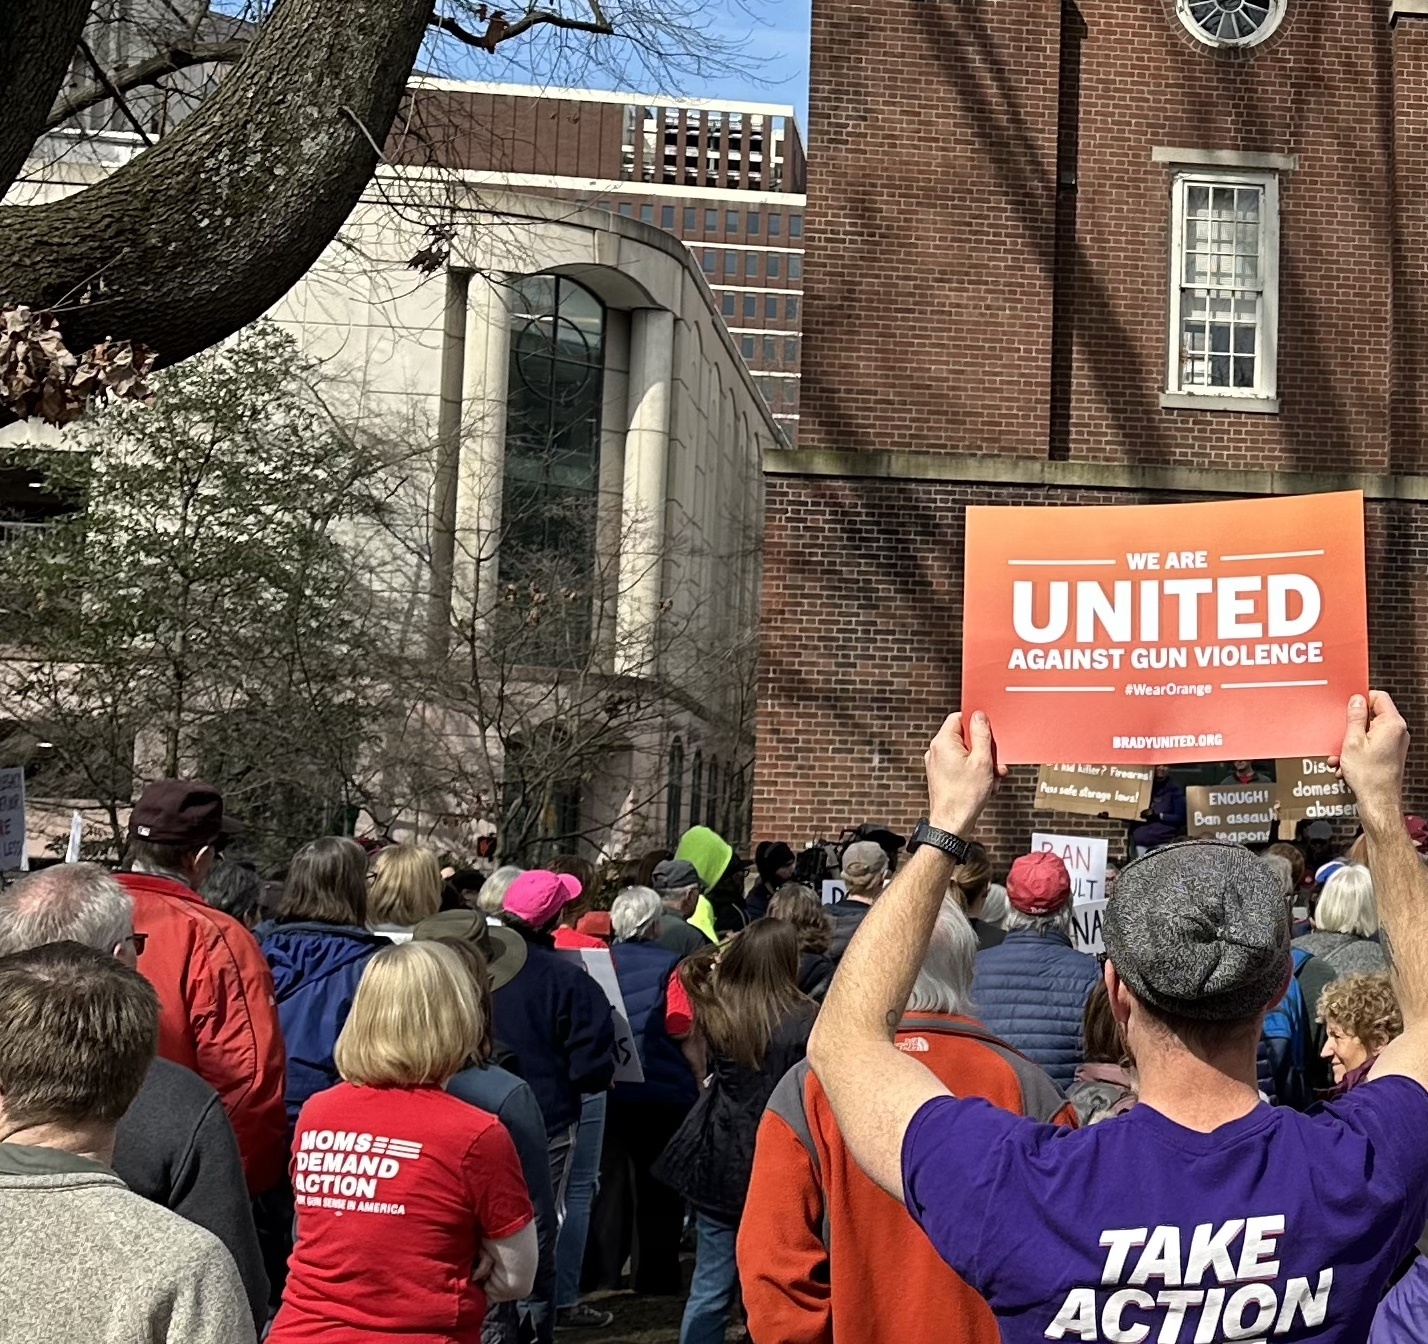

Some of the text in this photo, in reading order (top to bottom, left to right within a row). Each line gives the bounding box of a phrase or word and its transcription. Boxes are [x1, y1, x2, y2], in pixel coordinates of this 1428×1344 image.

[1126, 551, 1208, 570] WE ARE
[1013, 574, 1322, 644] UNITED
[1007, 641, 1324, 670] AGAINST GUN VIOLENCE
[1124, 682, 1213, 697] #WearOrange
[1112, 733, 1223, 749] BRADYUNITED.ORG
[1040, 781, 1139, 803] Pass safe storage laws!
[1209, 790, 1268, 805] ENOUGH!
[1194, 811, 1221, 826] Ban
[300, 1130, 373, 1153] MOMS
[296, 1151, 399, 1178] DEMAND
[296, 1173, 377, 1198] ACTION
[357, 1201, 406, 1215] AMERICA
[1099, 1214, 1285, 1287] TAKE
